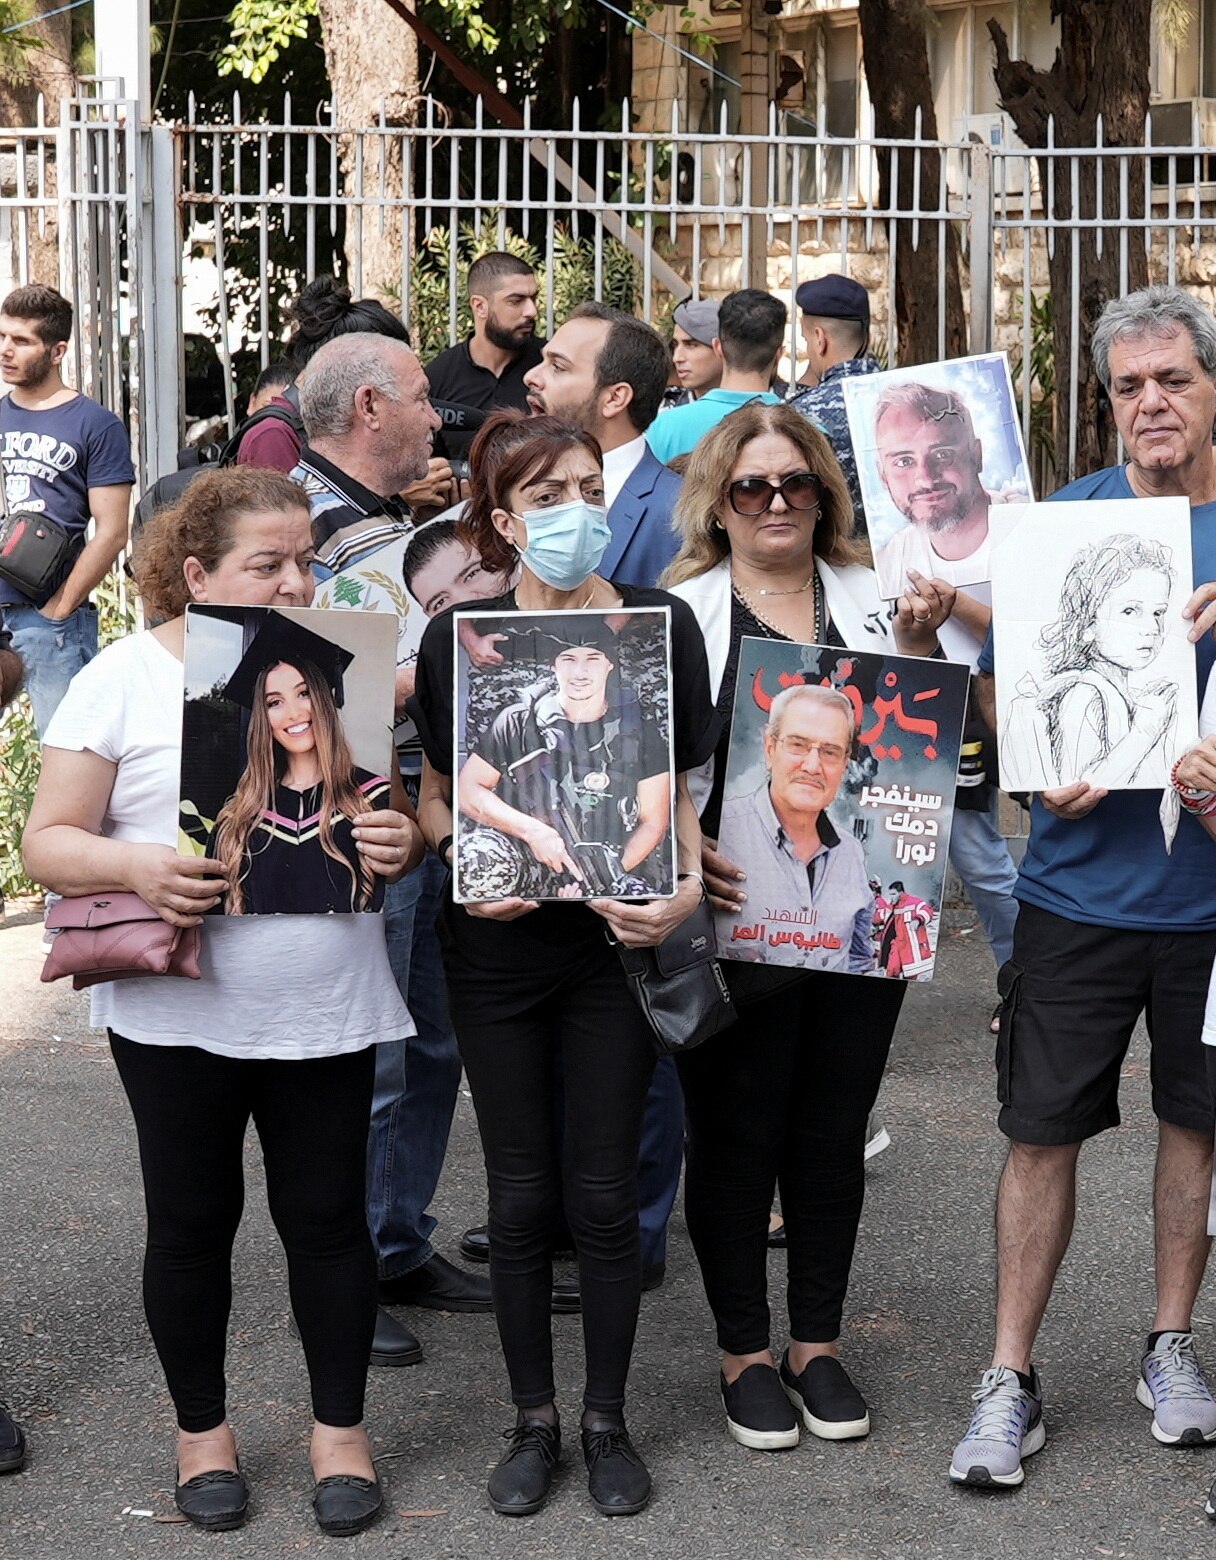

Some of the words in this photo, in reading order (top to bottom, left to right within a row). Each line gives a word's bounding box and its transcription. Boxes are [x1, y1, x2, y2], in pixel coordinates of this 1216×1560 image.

[0, 431, 78, 472] FORD
[859, 784, 942, 813] سينفجر
[884, 812, 938, 837] دمك
[761, 905, 818, 926] الشهيد
[730, 924, 766, 943] المر
